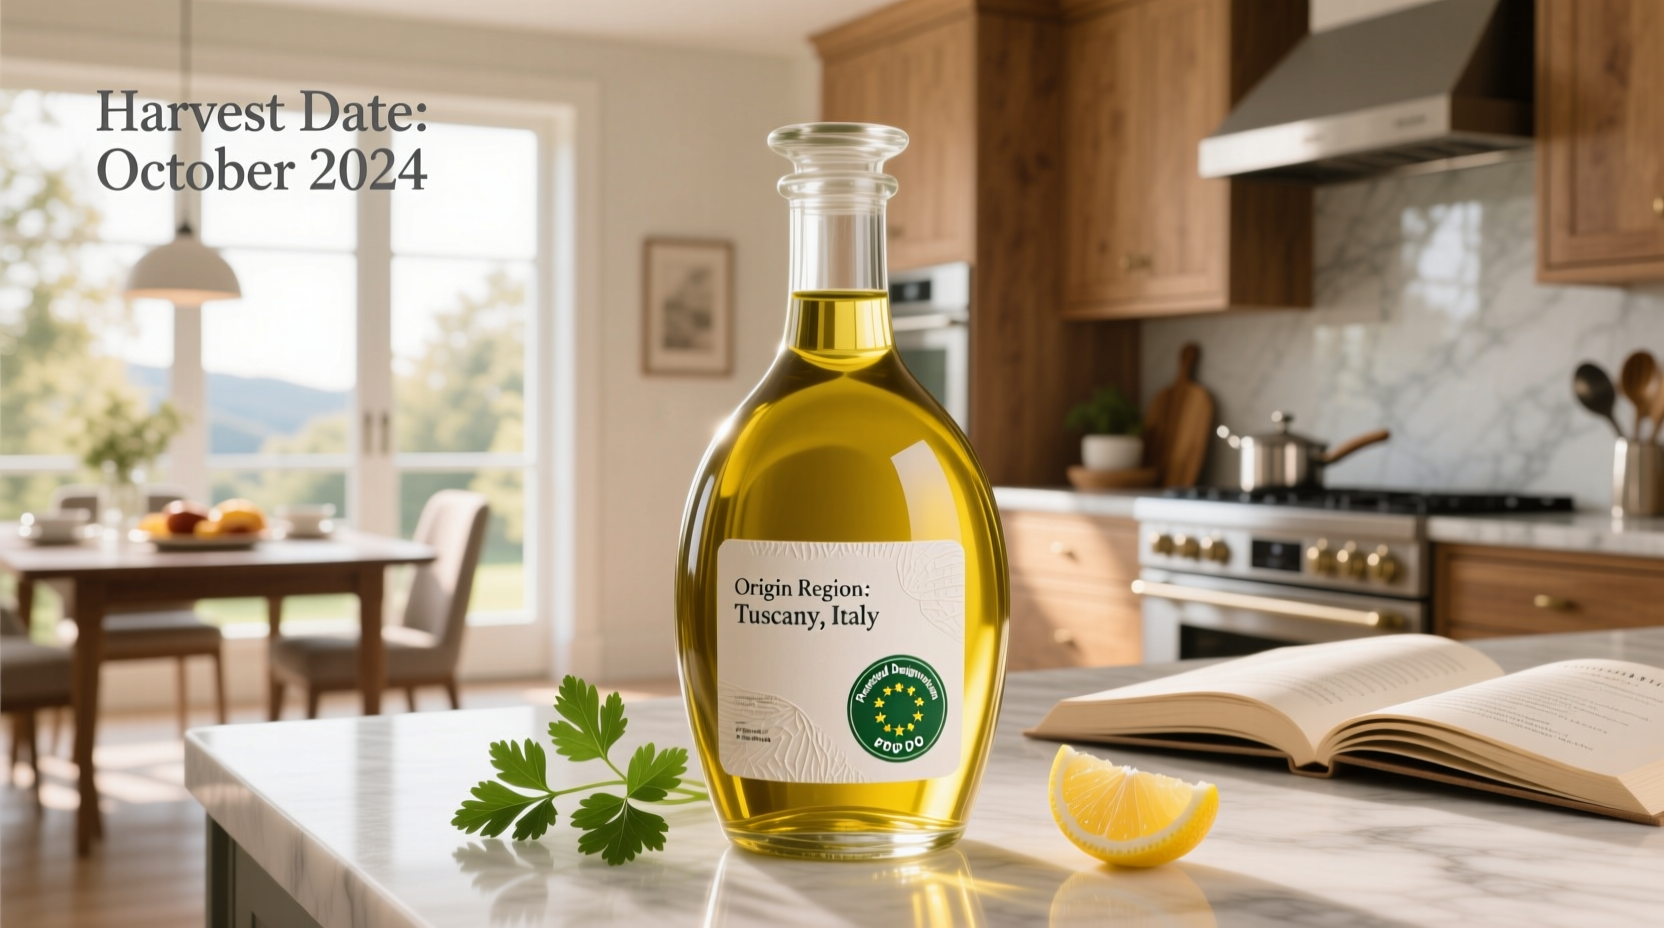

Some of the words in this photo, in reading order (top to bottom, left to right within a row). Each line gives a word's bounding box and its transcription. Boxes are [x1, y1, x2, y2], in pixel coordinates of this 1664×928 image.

[735, 578, 792, 601] Origin
[798, 579, 871, 602] Region:
[735, 604, 826, 631] Tuscany,
[832, 604, 881, 631] Italy
